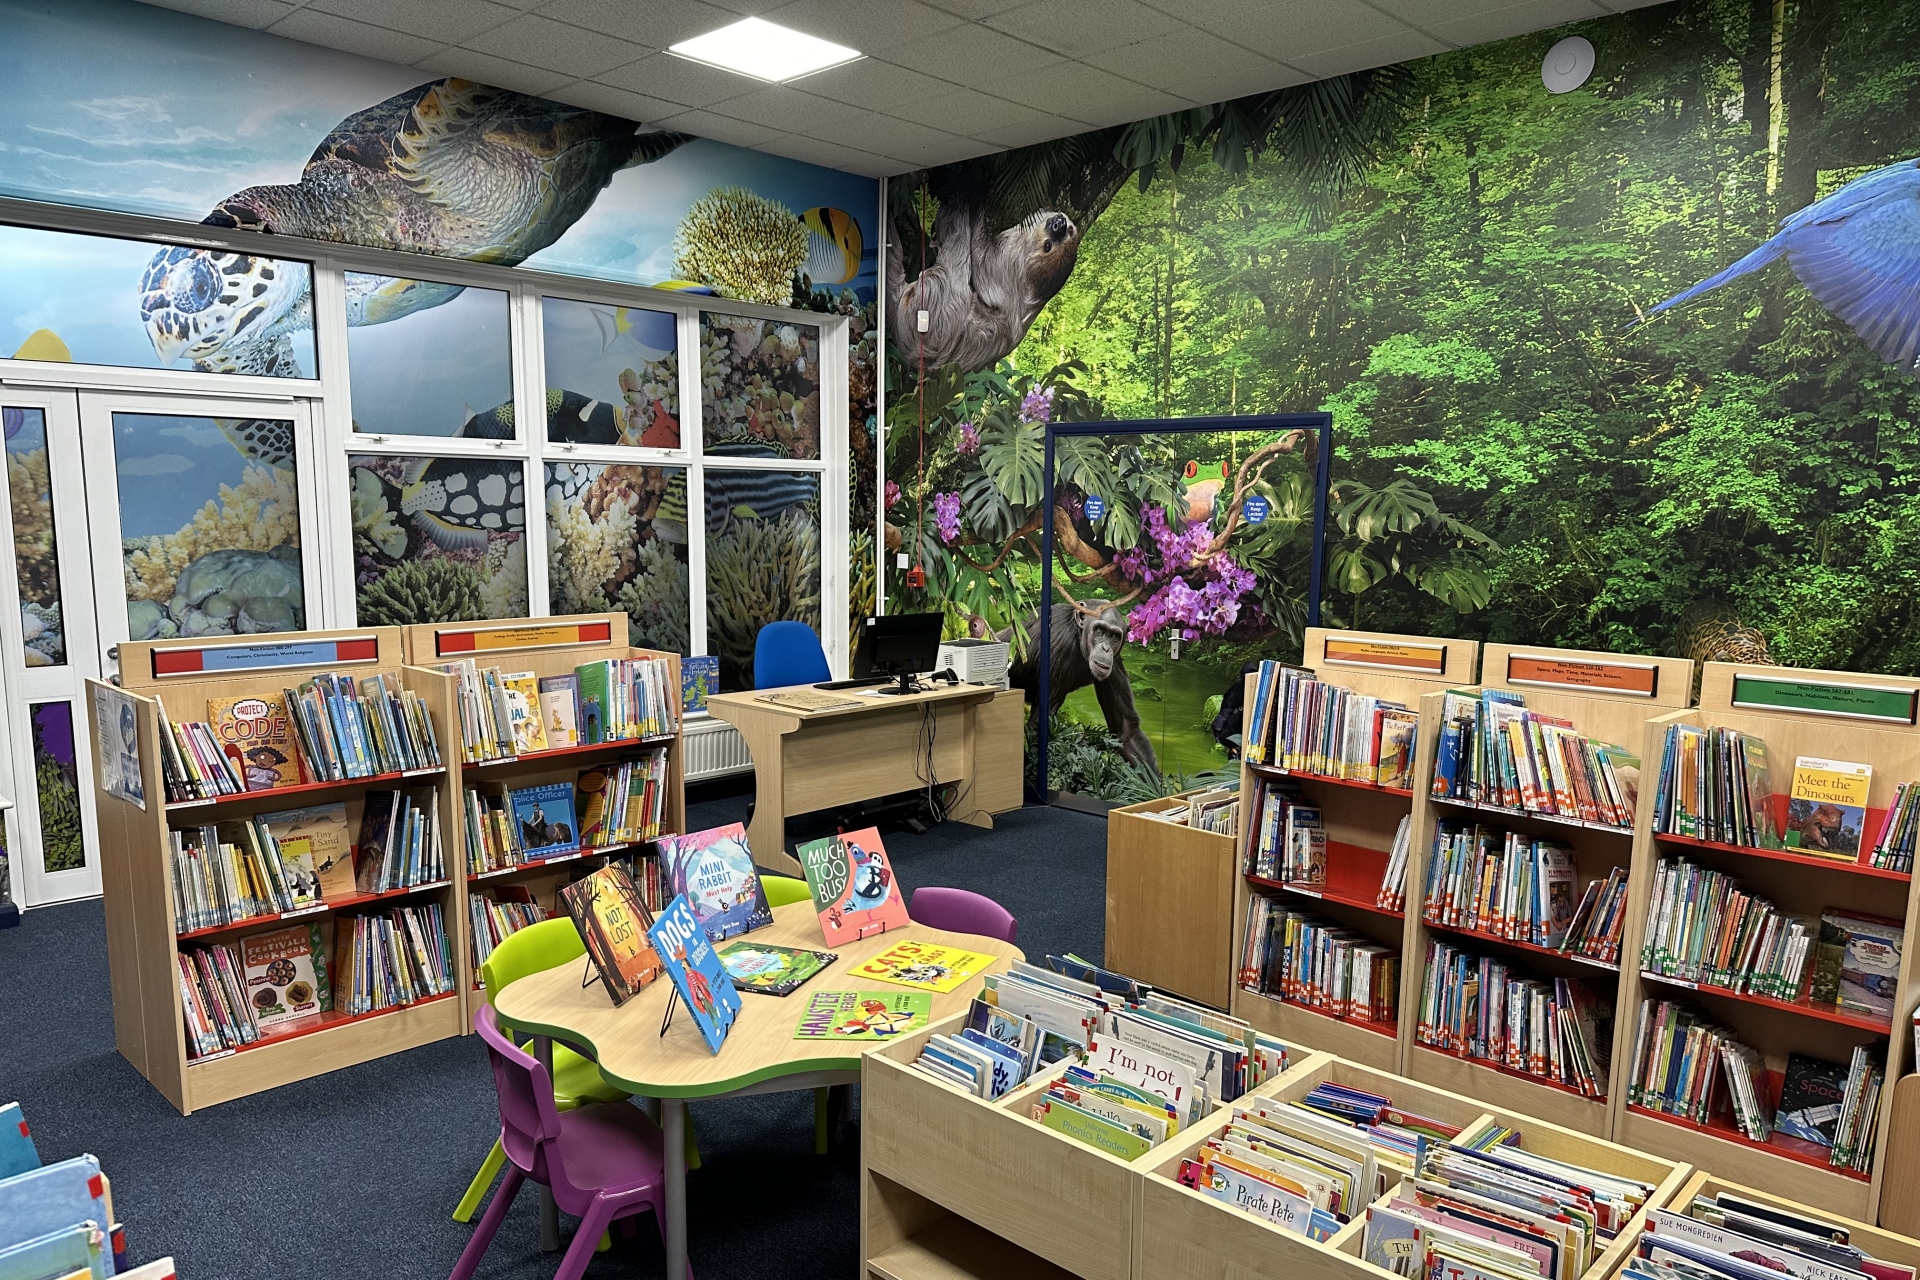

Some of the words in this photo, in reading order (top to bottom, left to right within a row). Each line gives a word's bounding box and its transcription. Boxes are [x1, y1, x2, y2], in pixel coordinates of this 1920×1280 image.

[1775, 690, 1804, 698] Dinosaurs,
[1805, 692, 1831, 700] Habitats,
[1832, 695, 1855, 703] Nature,
[1797, 685, 1831, 693] Non-Fiction
[237, 704, 264, 715] PROJECT
[219, 717, 287, 742] CODE
[1797, 773, 1828, 788] Meet
[1831, 778, 1851, 790] the
[537, 791, 566, 800] Officer
[1796, 786, 1855, 804] Dinosaurs
[315, 831, 332, 839] Tiny
[317, 836, 340, 847] Sand
[808, 844, 845, 867] MUCH
[700, 860, 725, 876] MINI
[810, 860, 846, 883] TOO
[698, 871, 732, 890] RABBIT
[706, 889, 720, 898] Must
[720, 886, 733, 895] Help
[818, 877, 847, 904] BUSY
[605, 907, 623, 926] NOT
[609, 921, 633, 944] LOST
[657, 902, 696, 963] DOGS
[248, 938, 306, 955] FESTIVALS
[249, 945, 308, 964] COOKBOOK
[863, 945, 922, 974] CATS
[840, 992, 858, 1012] HEROES
[798, 992, 842, 1036] HAMSTER
[1108, 1047, 1138, 1072] I'm
[1145, 1063, 1175, 1086] not
[1800, 1080, 1844, 1100] Space
[1085, 1120, 1109, 1135] Usborne
[1062, 1120, 1093, 1140] Phonics
[1096, 1134, 1129, 1155] Readers
[1236, 1184, 1268, 1213] Pirate
[1270, 1198, 1294, 1223] Pete
[1659, 1217, 1673, 1228] SUE
[1675, 1222, 1724, 1244] MONGREDIEN
[1514, 1241, 1537, 1255] FREE
[1807, 1265, 1826, 1278] NICK
